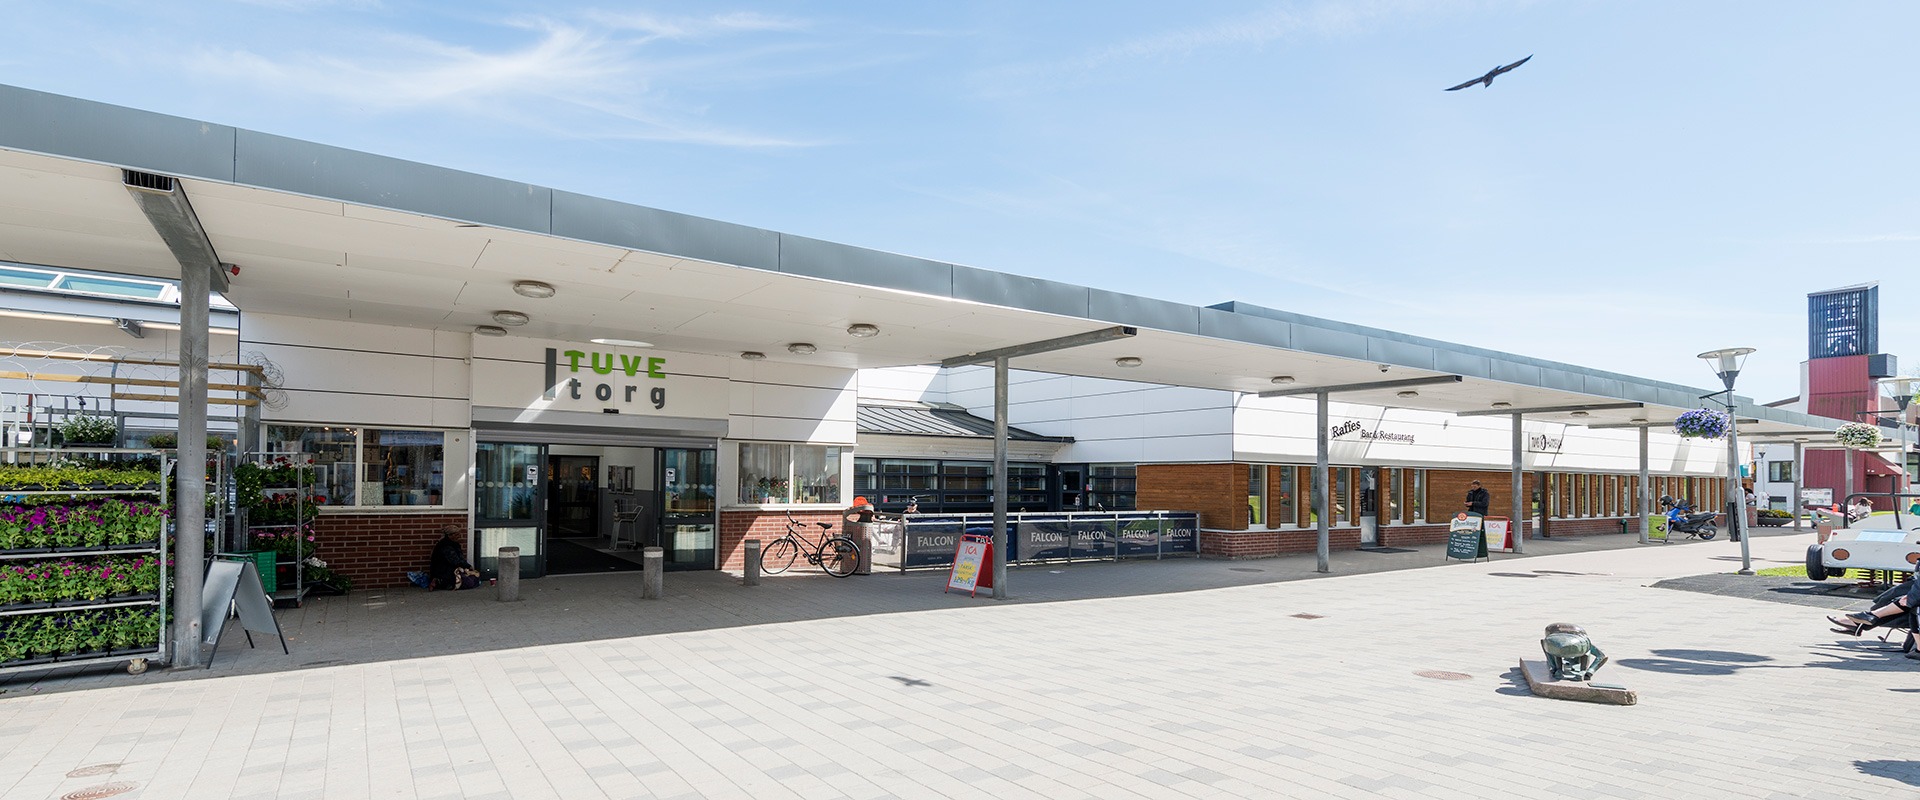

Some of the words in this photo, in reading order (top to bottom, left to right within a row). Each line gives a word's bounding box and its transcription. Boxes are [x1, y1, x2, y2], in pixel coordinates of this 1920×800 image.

[564, 350, 666, 378] TUVE
[568, 377, 666, 410] torg
[1360, 429, 1373, 439] Bar
[1379, 431, 1415, 445] Restaurang
[1030, 532, 1063, 543] FALCON
[1077, 530, 1107, 541] FALCON
[1122, 529, 1150, 540] FALCON
[1166, 528, 1192, 538] FALCON
[917, 536, 954, 547] FALCON
[964, 545, 977, 555] ICA
